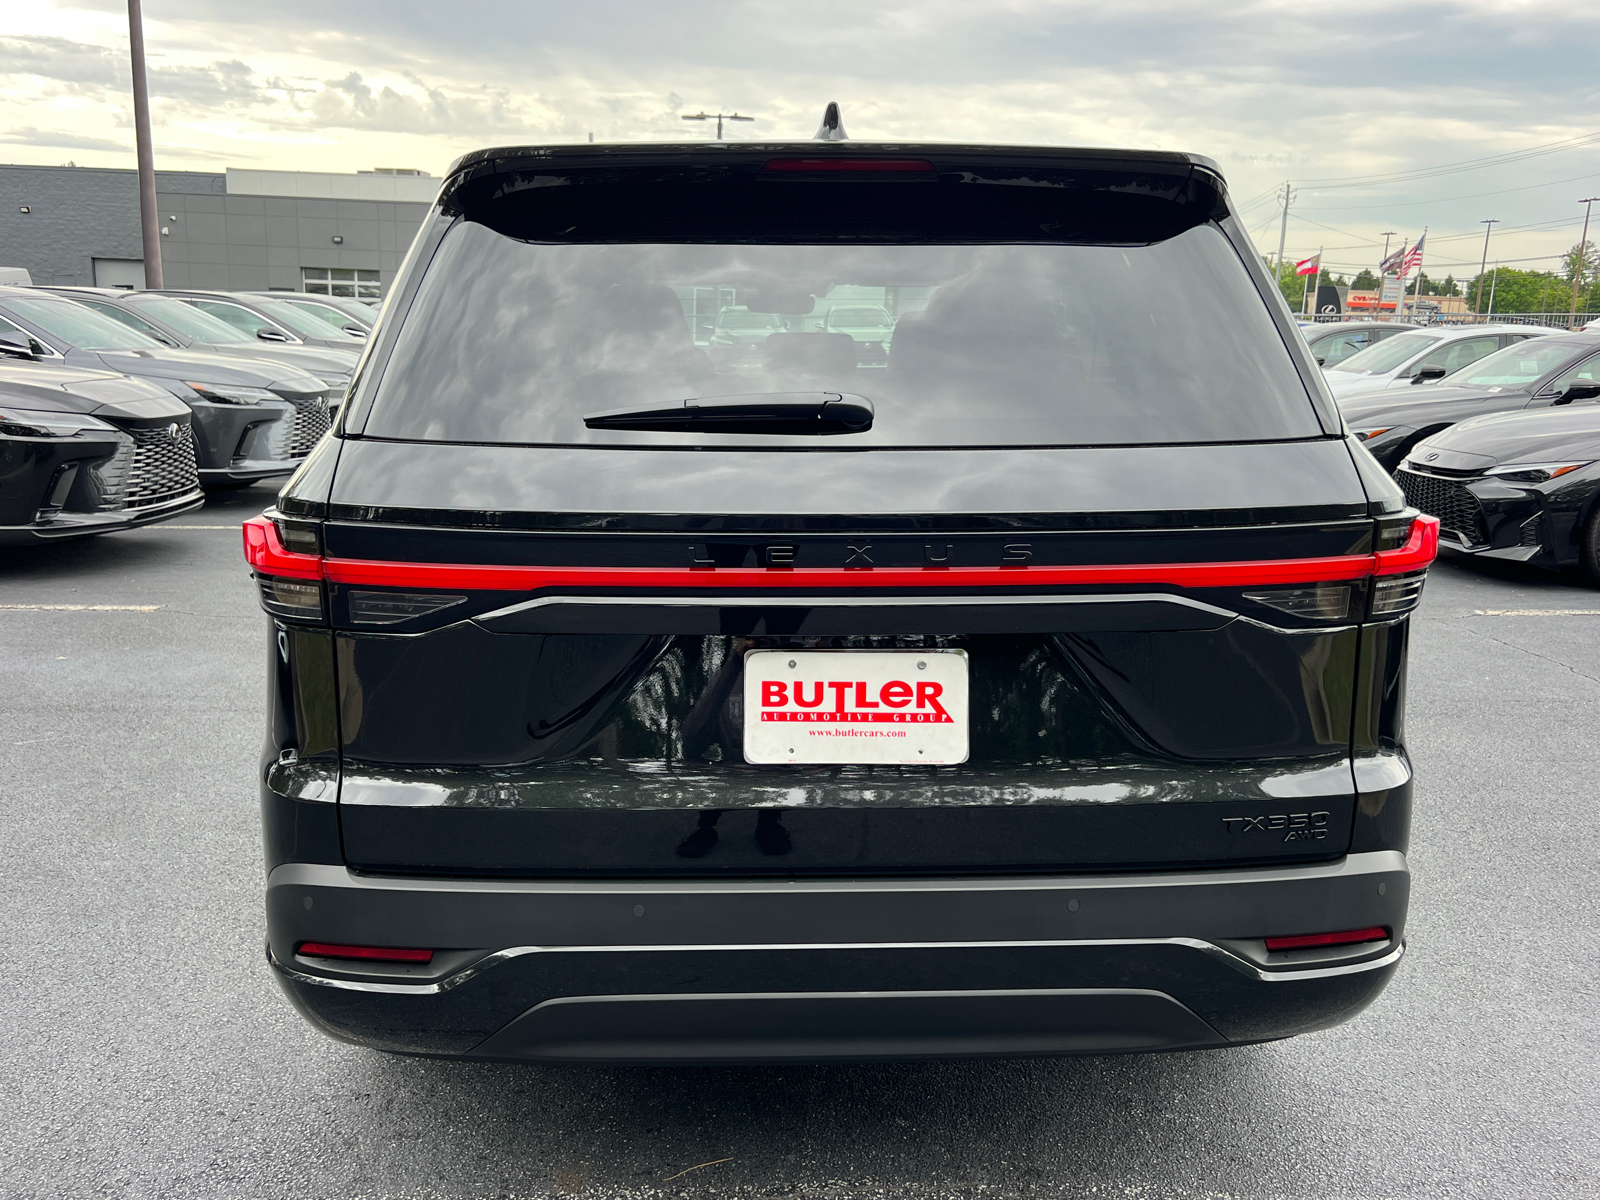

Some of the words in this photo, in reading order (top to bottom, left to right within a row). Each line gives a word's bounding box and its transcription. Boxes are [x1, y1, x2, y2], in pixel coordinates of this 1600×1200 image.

[688, 543, 1033, 564] LEXUS
[761, 712, 874, 722] AUTOMOTIVE
[893, 713, 949, 722] GROUP
[808, 728, 907, 738] www.butlercars.com
[1221, 811, 1331, 833] TX350
[1284, 828, 1328, 843] AWD
